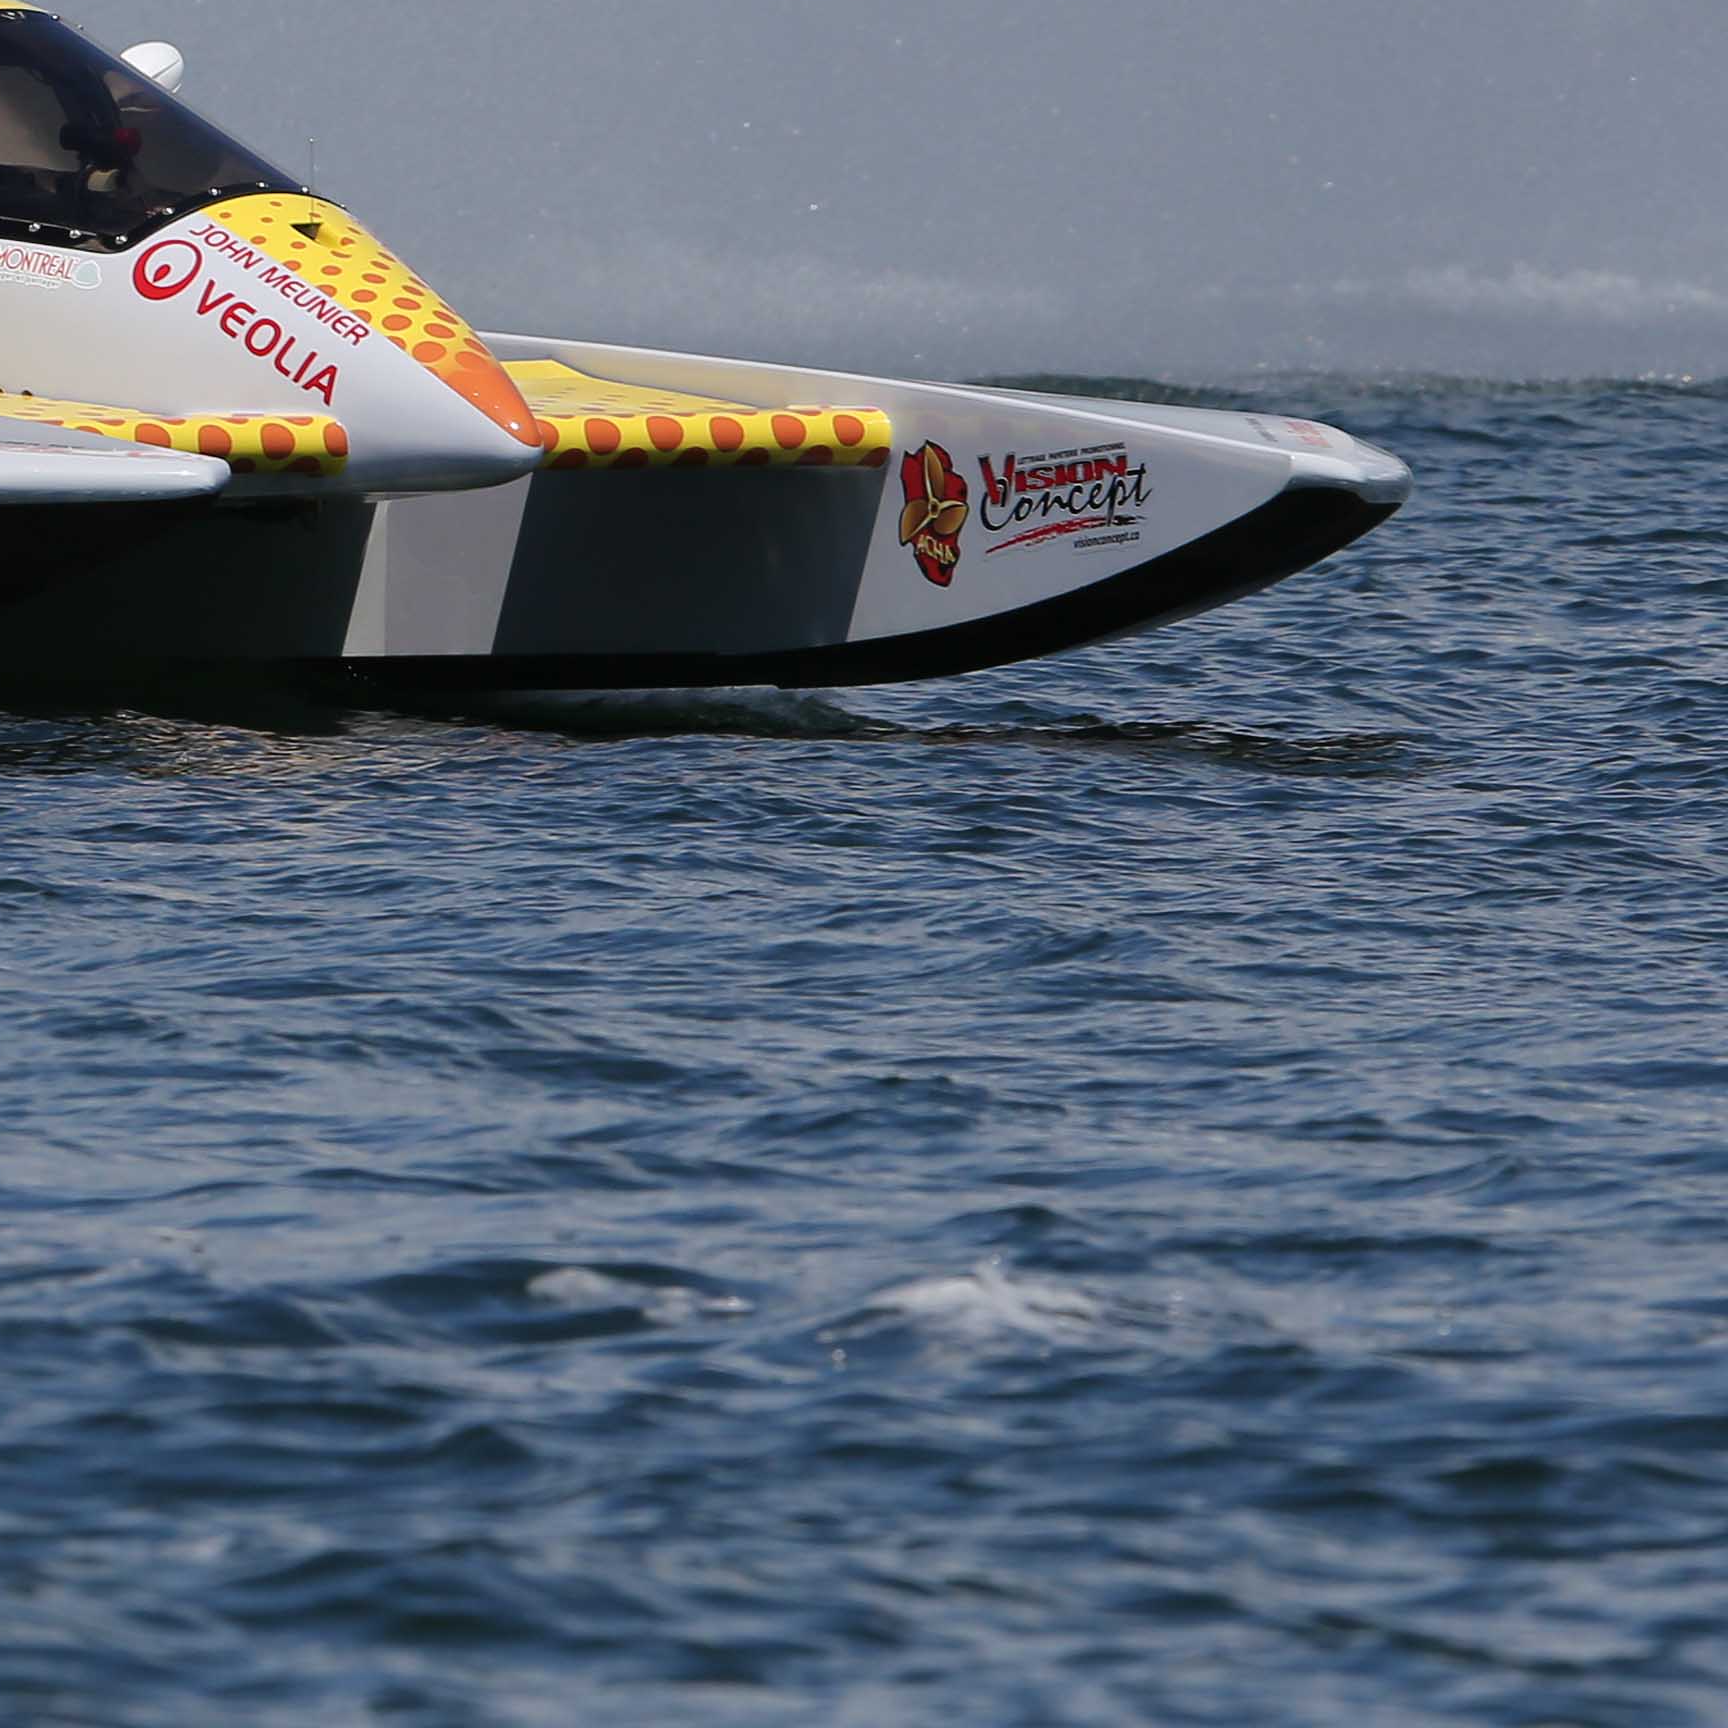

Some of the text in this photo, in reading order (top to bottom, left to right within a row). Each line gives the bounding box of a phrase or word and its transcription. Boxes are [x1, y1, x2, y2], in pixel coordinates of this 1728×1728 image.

[189, 223, 370, 346] JOHN MEUNIER
[196, 278, 339, 407] VEOLIA
[980, 462, 1153, 531] Concept
